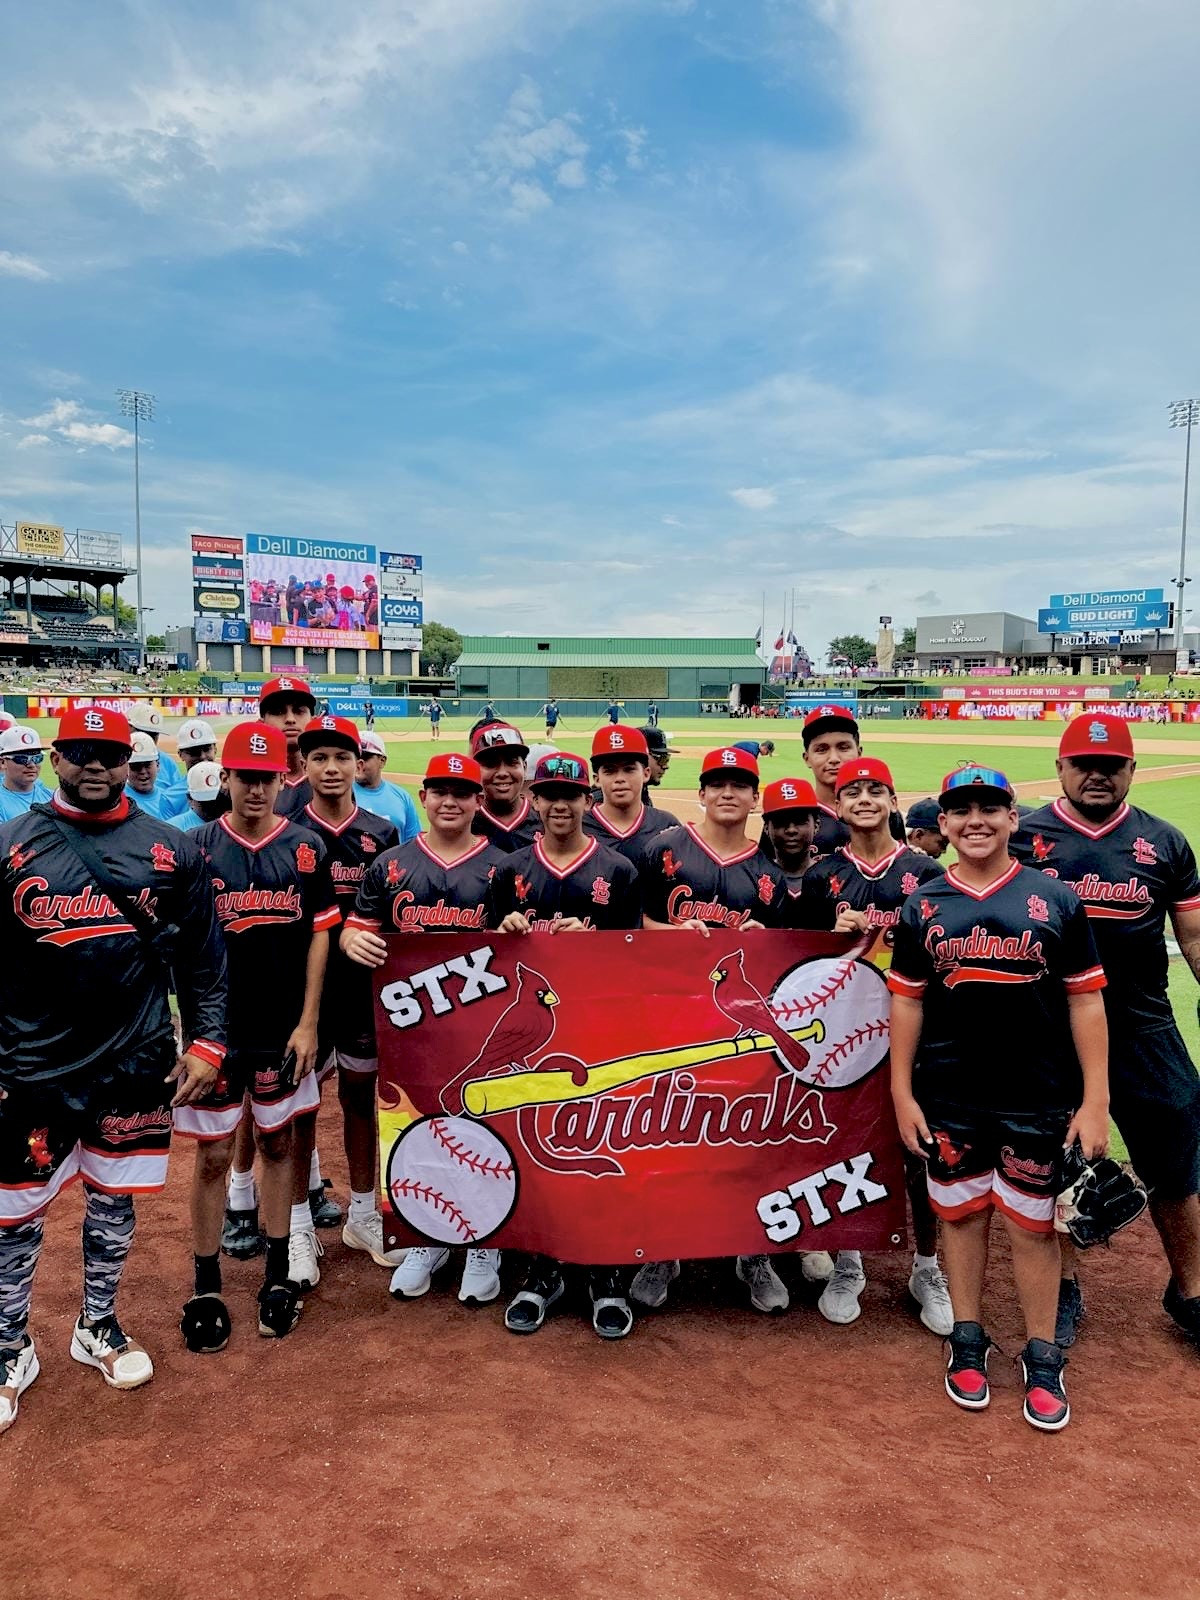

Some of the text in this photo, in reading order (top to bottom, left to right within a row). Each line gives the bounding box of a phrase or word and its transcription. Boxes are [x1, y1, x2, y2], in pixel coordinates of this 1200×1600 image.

[20, 526, 60, 538] GOLDEN
[24, 533, 57, 544] CHICK
[258, 536, 368, 561] Dell Diamond
[205, 594, 235, 602] Chicken
[1063, 591, 1146, 606] Dell Diamond
[384, 604, 420, 616] GOYA
[1070, 609, 1135, 622] BUD LIGHT
[1062, 634, 1142, 646] BULLPEN BAR
[1005, 688, 1028, 696] BUD'S
[1029, 688, 1044, 696] FOR
[1045, 688, 1061, 696] YOU
[336, 703, 358, 711] DELL
[925, 924, 1046, 968] Cardinals
[379, 945, 508, 1028] STX
[516, 1052, 838, 1179] Cardinals
[756, 1151, 888, 1243] STX
